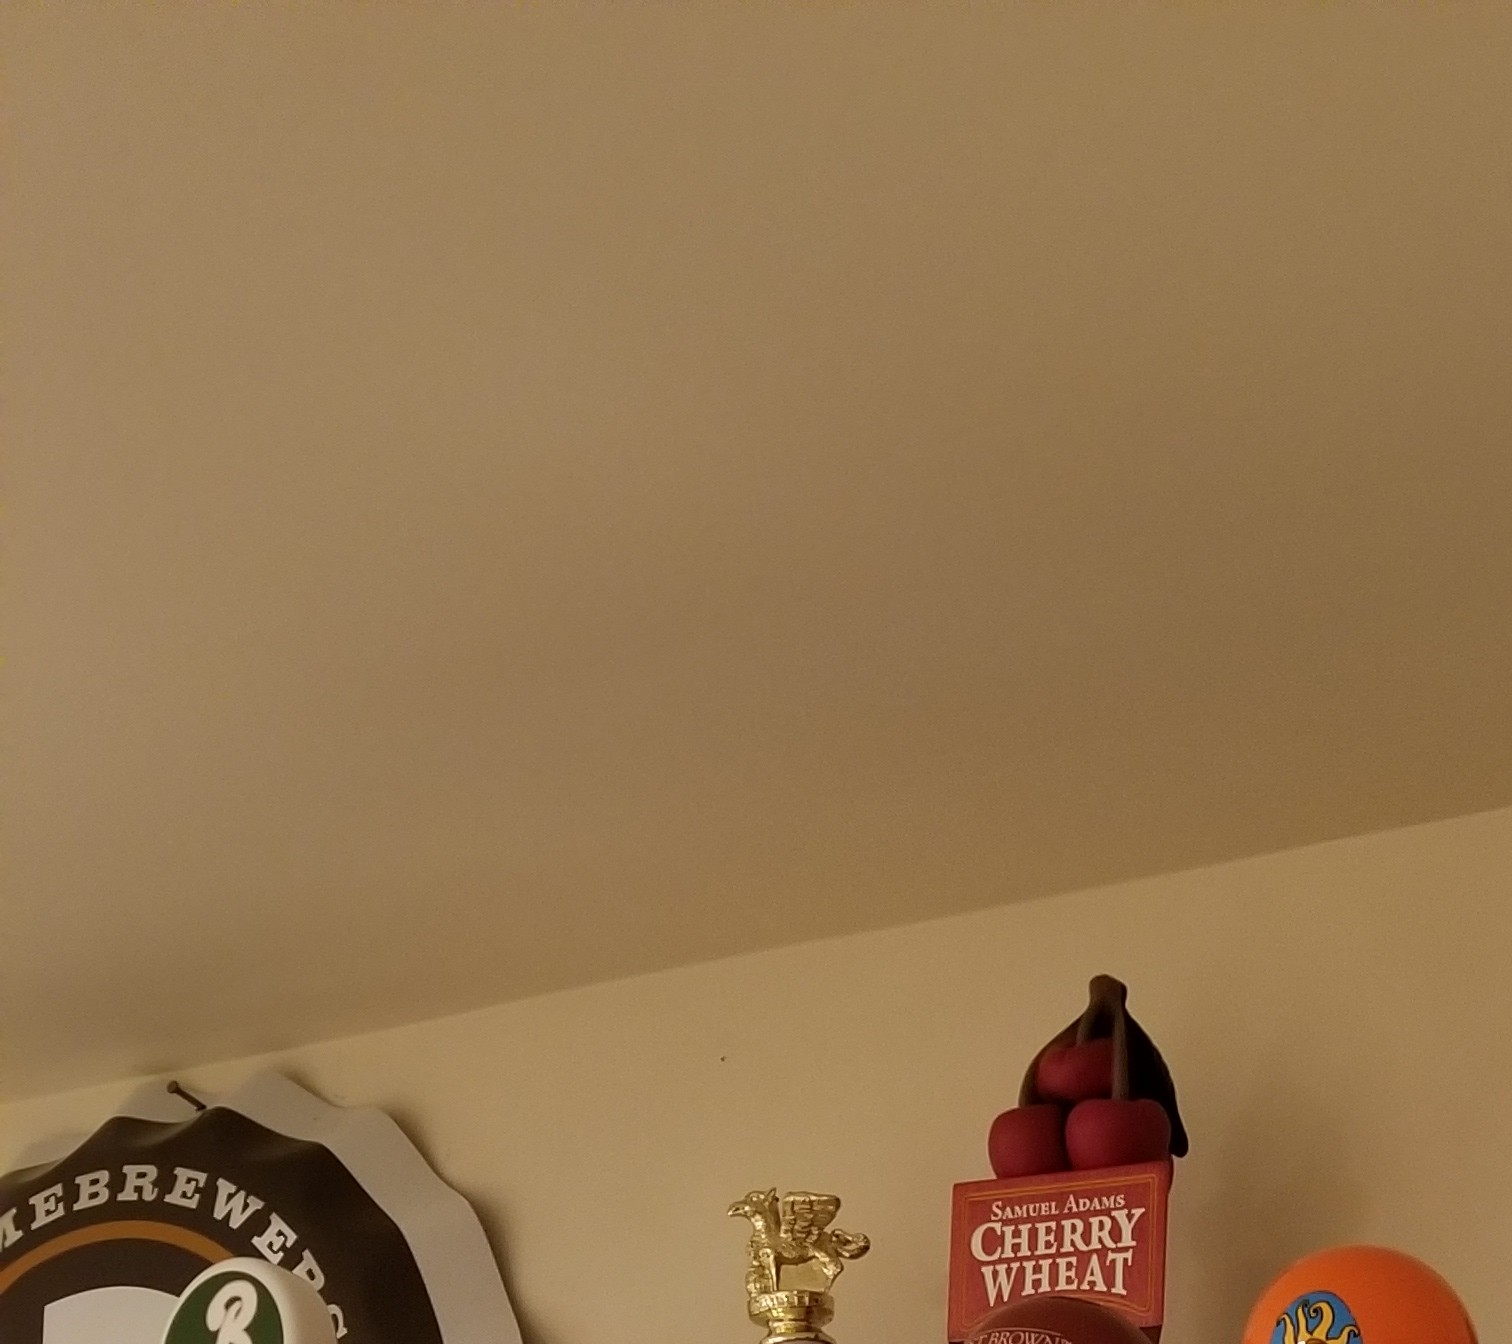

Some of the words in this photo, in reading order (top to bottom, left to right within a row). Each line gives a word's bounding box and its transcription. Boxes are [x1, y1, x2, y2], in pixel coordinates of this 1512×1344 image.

[970, 1207, 1146, 1262] CHERRY
[989, 1200, 1059, 1222] SAMUEL
[1063, 1194, 1125, 1213] ADAMS
[980, 1248, 1133, 1307] WHEAT
